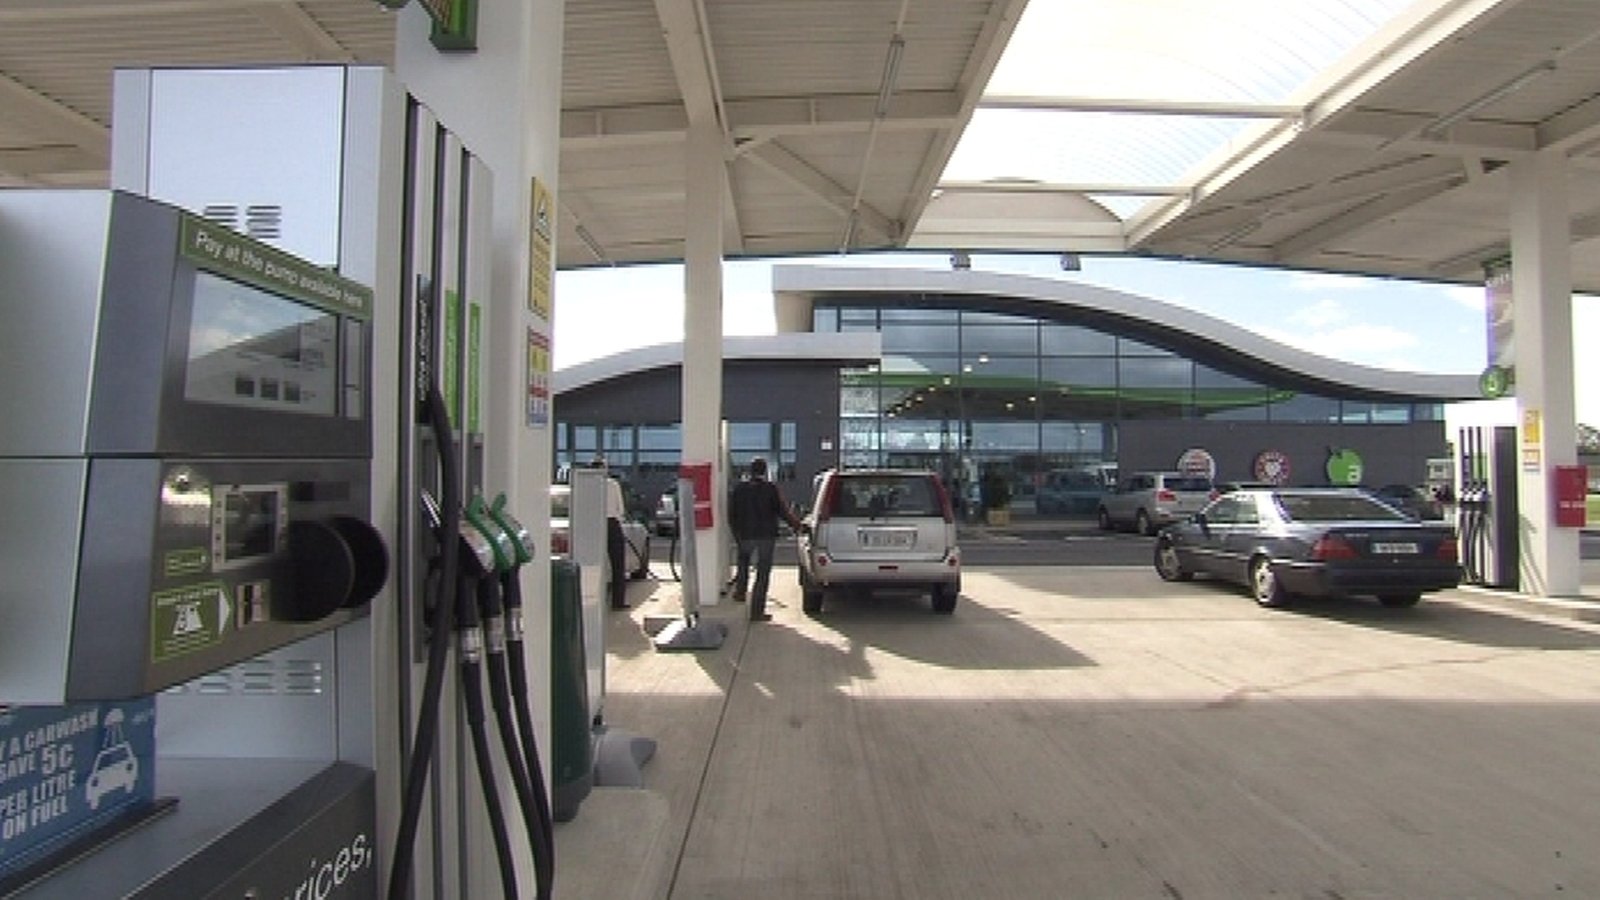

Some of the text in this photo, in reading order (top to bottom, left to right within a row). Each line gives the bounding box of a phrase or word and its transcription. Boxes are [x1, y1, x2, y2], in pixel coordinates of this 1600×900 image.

[195, 231, 222, 258] Pay
[224, 246, 240, 262] at
[241, 251, 264, 272] the
[265, 263, 299, 286] pump
[24, 707, 99, 749] CARWASH
[0, 751, 35, 784] SAVE
[0, 769, 77, 819] PER LITRE
[3, 795, 69, 840] ON FULL
[284, 834, 373, 900] rices,
